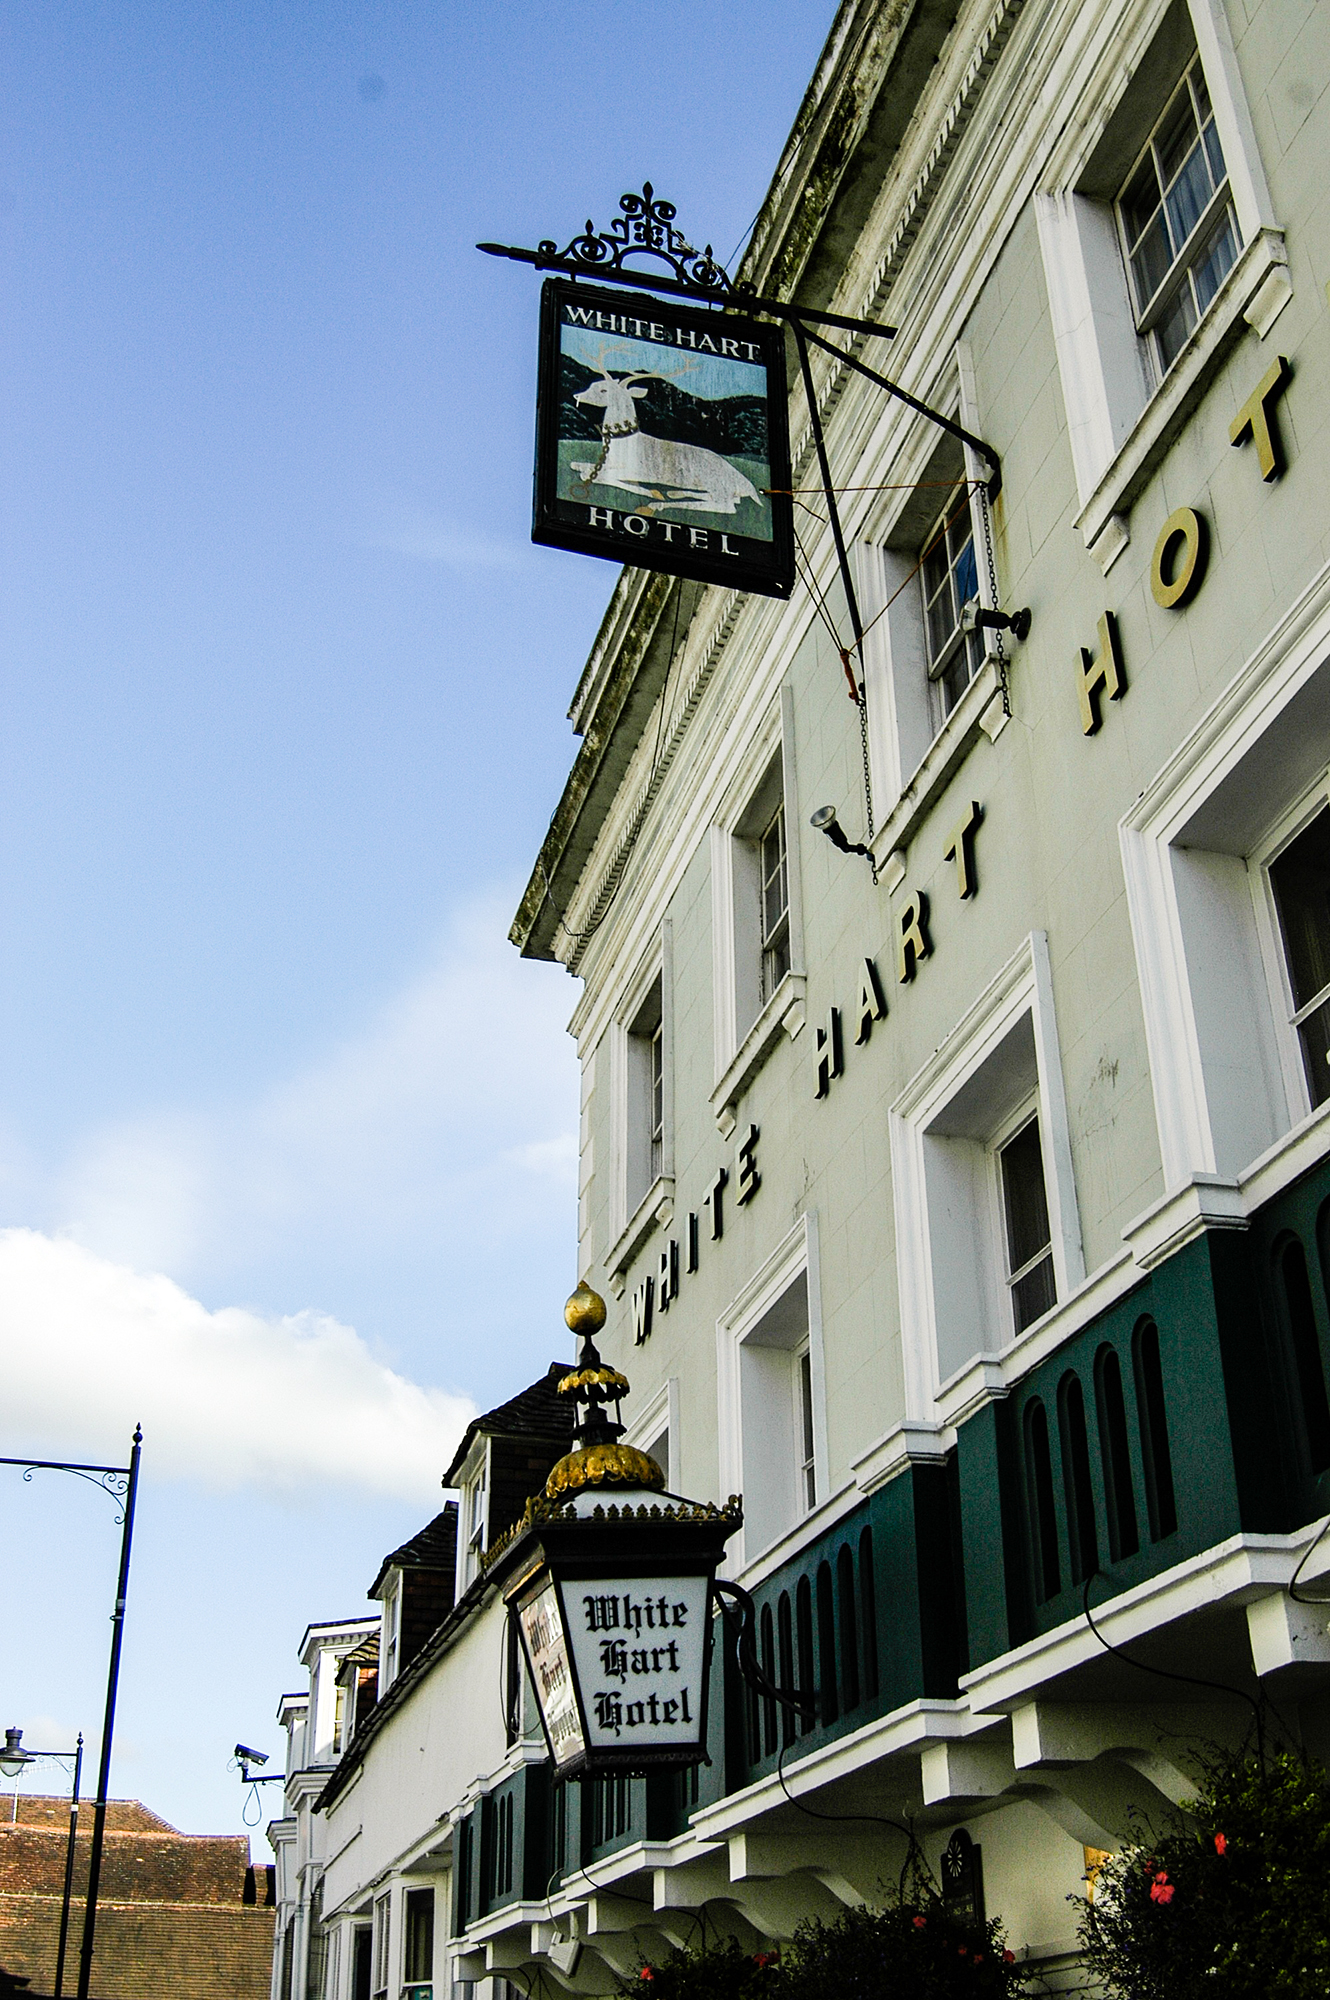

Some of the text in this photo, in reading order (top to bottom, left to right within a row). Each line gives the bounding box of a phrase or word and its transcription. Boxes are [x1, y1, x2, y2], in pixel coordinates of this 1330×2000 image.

[565, 304, 760, 361] WHITE HART
[588, 506, 739, 556] HOTEL
[631, 280, 1330, 1346] WHITE HART HOT
[583, 1594, 688, 1639] White
[599, 1639, 680, 1685] Hart
[594, 1687, 693, 1738] Hotel
